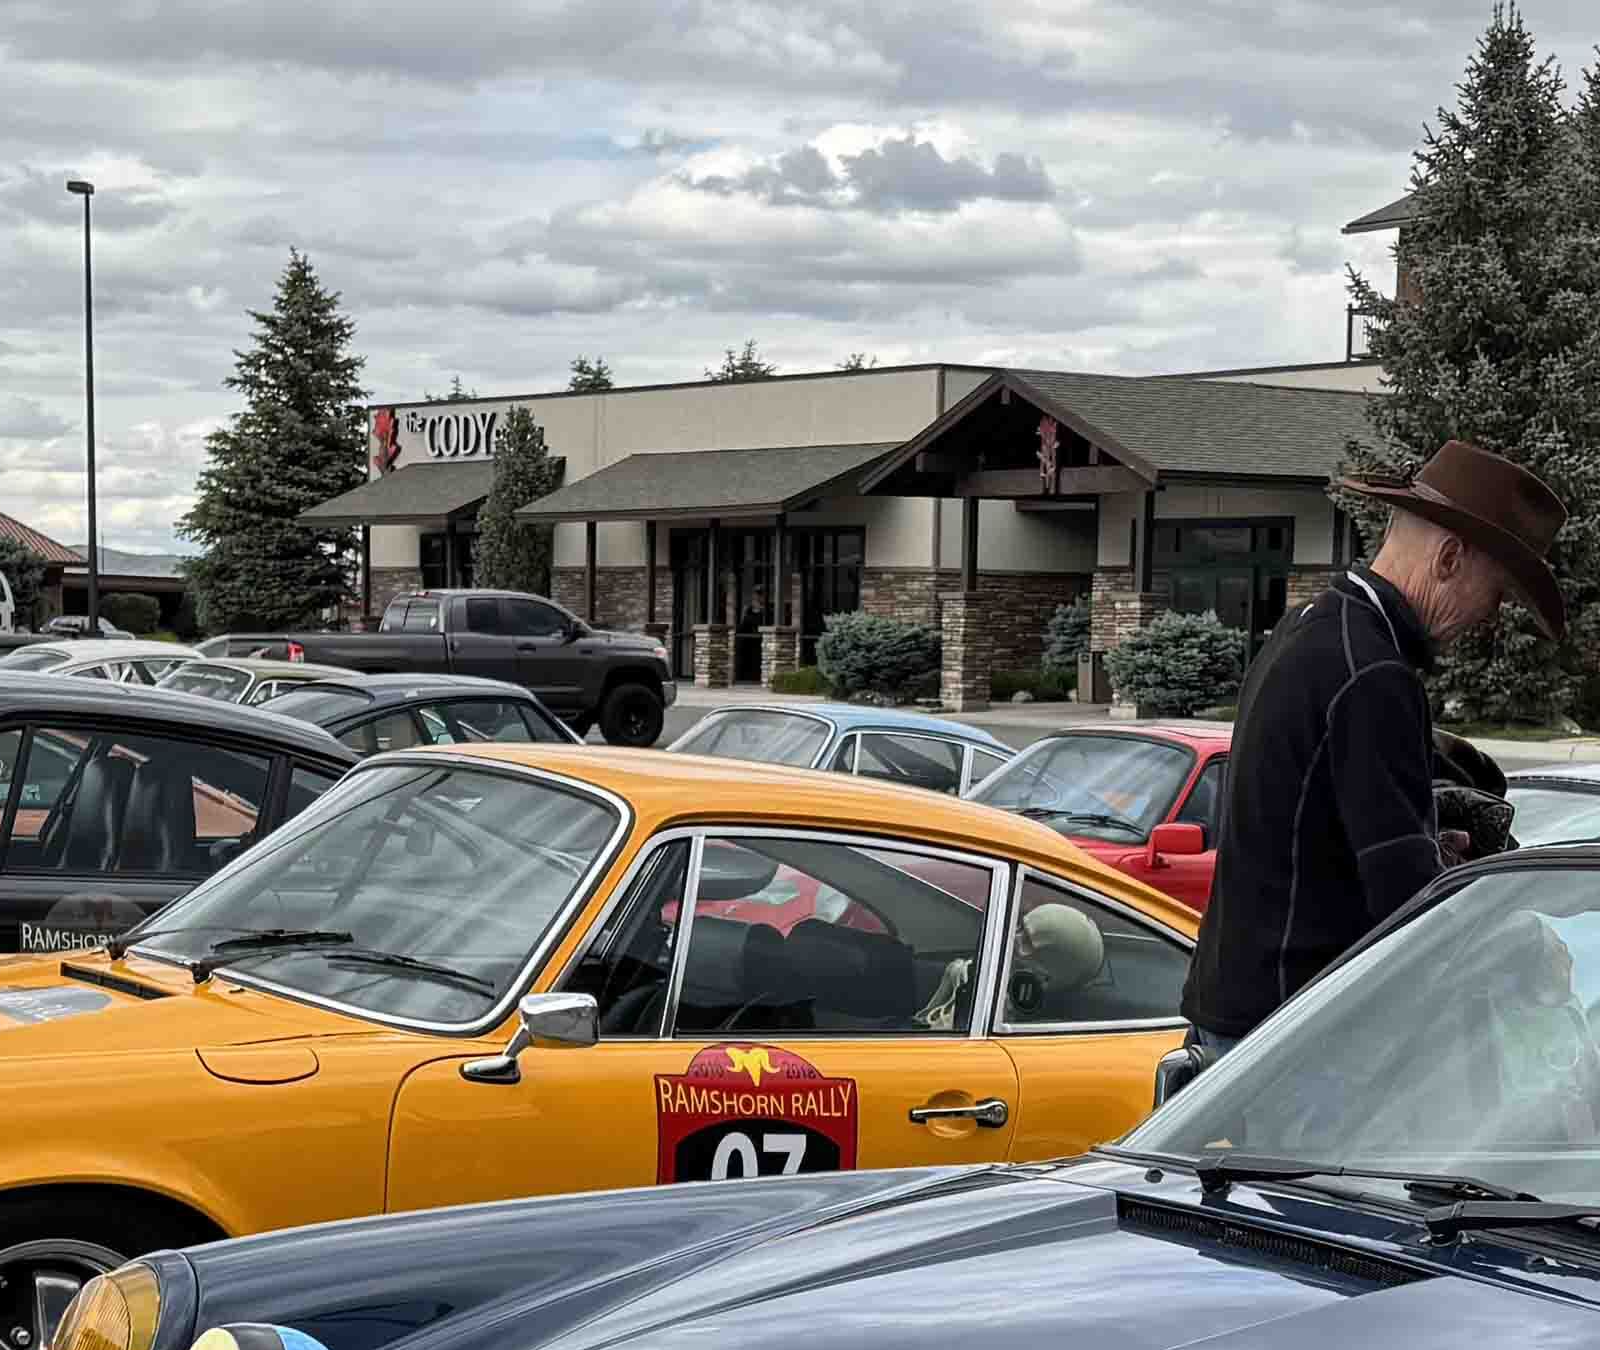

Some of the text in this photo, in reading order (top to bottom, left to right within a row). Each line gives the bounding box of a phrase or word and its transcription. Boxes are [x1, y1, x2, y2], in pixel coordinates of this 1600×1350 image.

[424, 411, 497, 458] CODY
[22, 922, 115, 952] RAMSHOR
[659, 1078, 851, 1117] RAMSHORN RALLY
